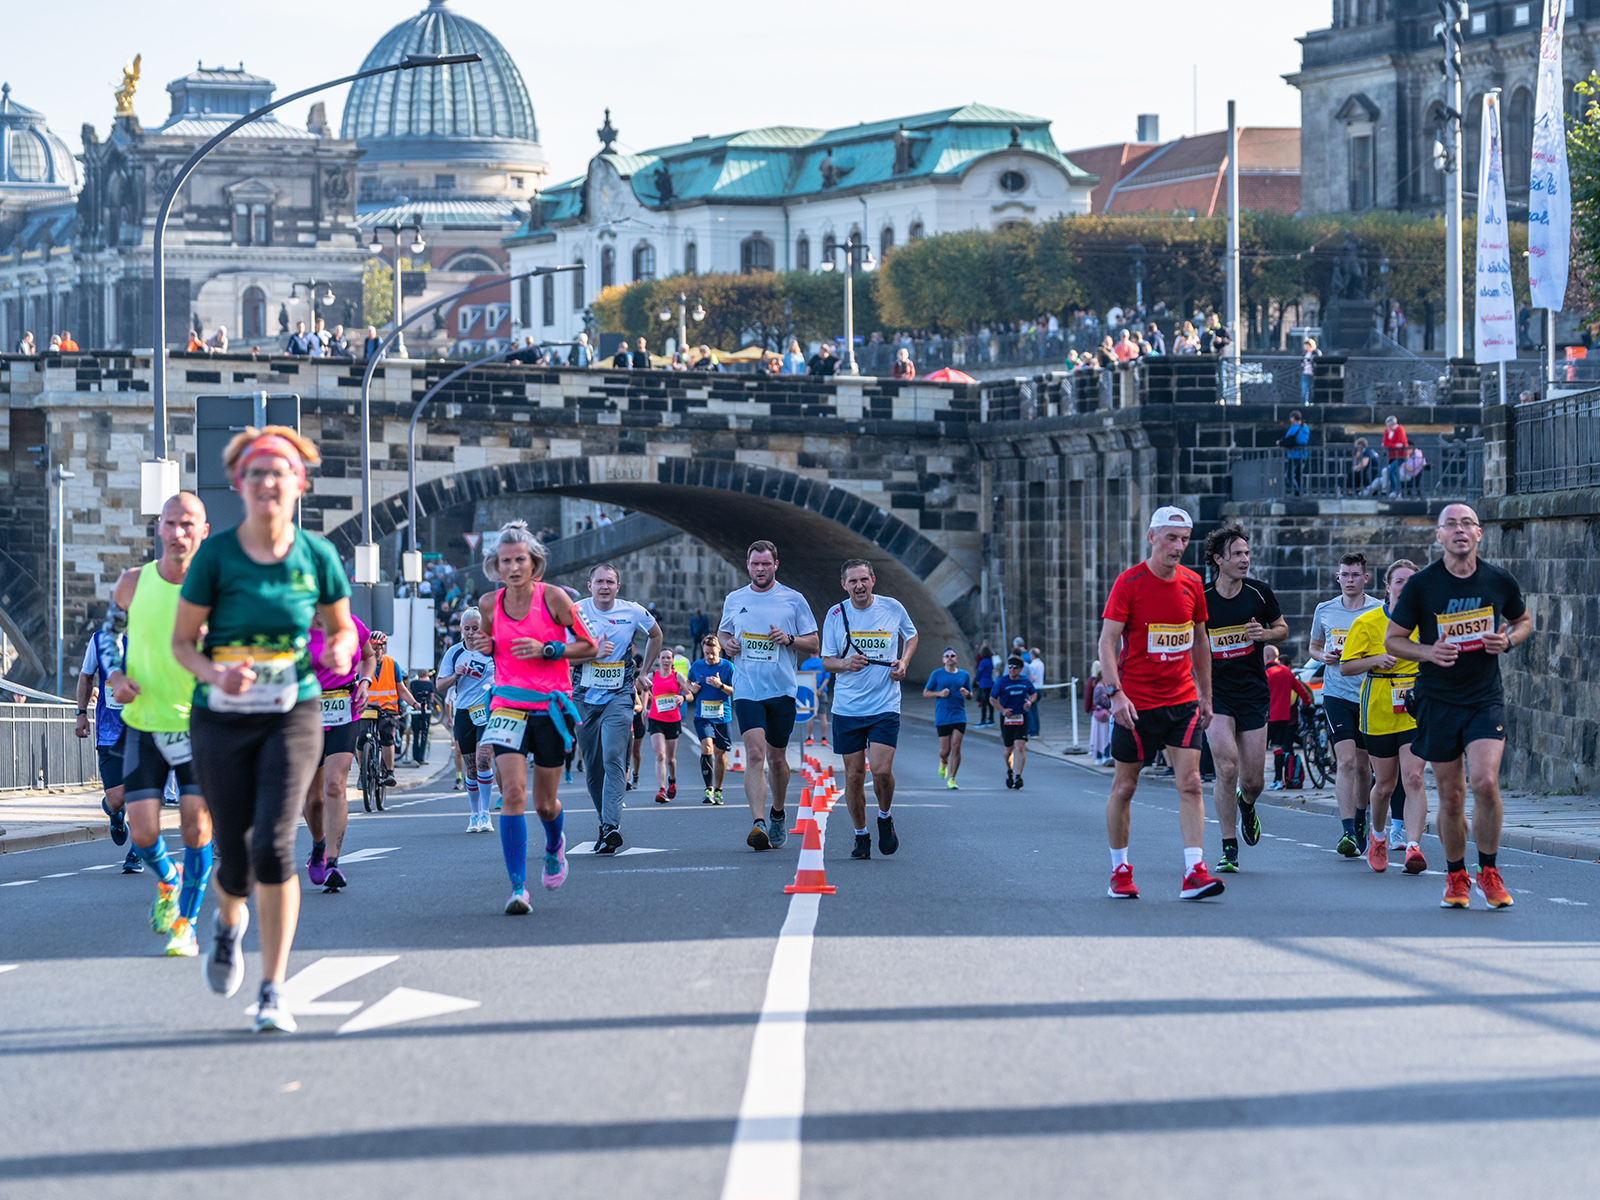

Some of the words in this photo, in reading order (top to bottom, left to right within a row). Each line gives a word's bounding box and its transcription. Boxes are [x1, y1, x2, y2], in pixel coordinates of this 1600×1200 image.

[1446, 597, 1482, 614] RUN
[1447, 618, 1488, 637] 40537
[747, 640, 774, 651] 20962
[854, 638, 886, 649] 20036
[1157, 632, 1189, 647] 41080
[1217, 633, 1247, 646] 41324
[594, 668, 621, 678] 20033
[488, 717, 518, 731] 2077
